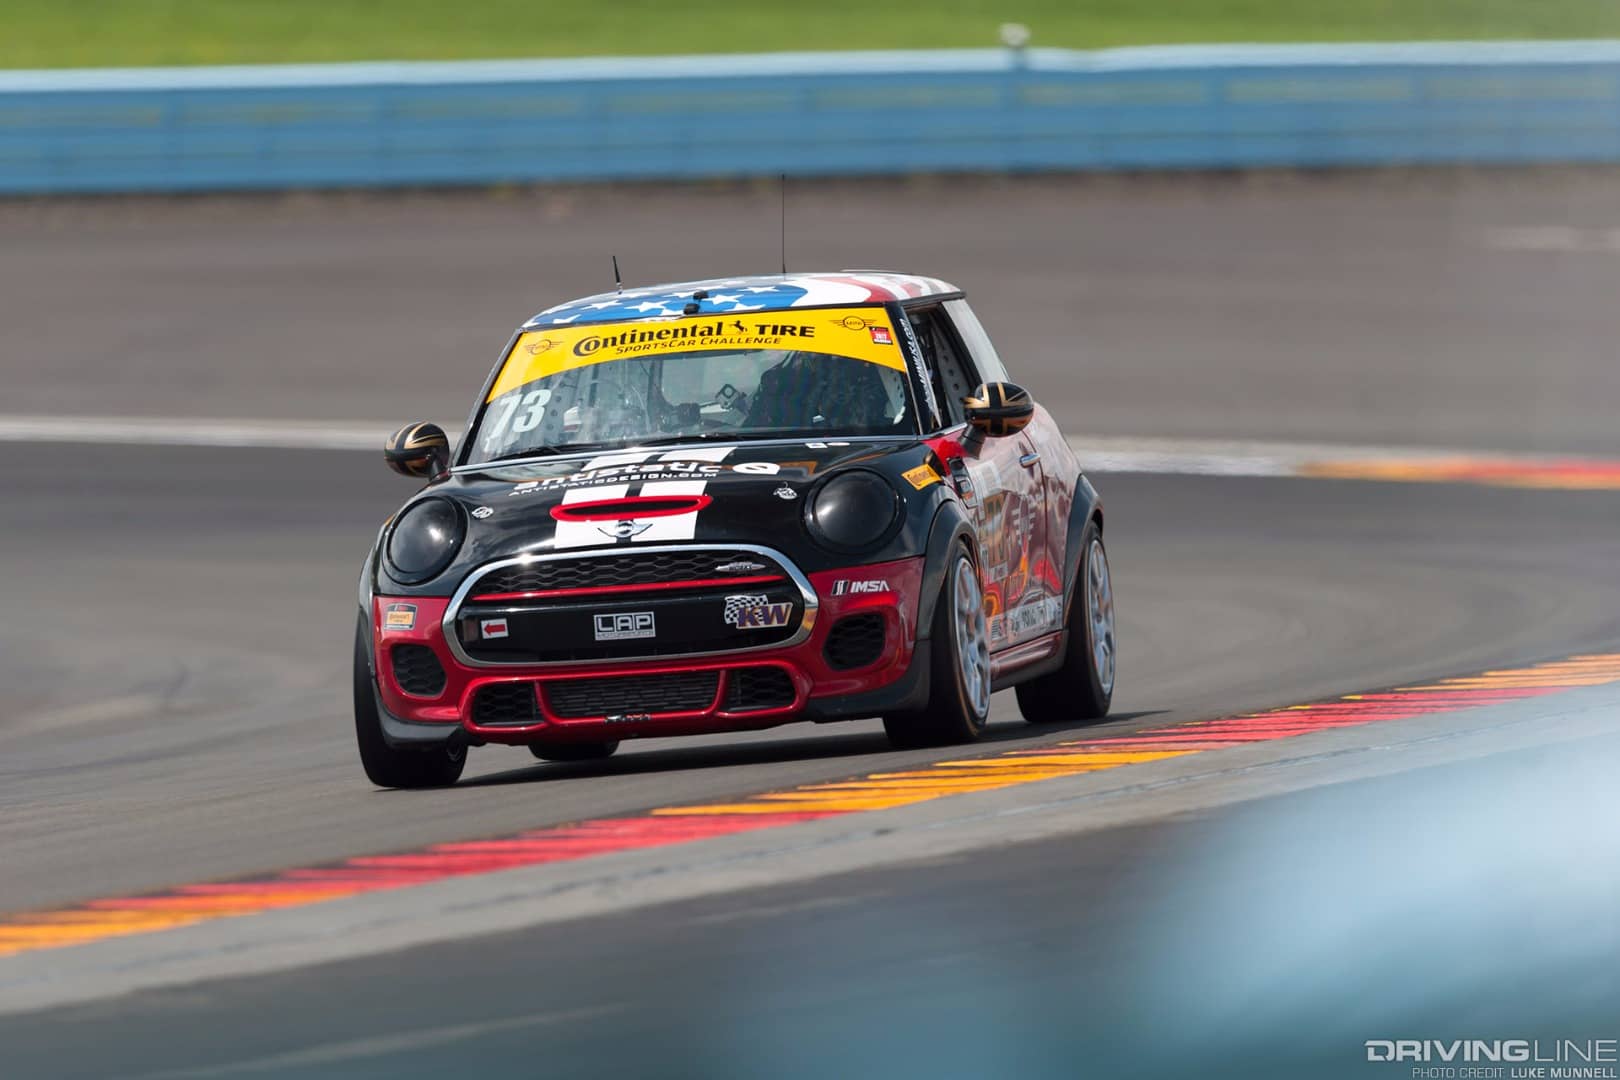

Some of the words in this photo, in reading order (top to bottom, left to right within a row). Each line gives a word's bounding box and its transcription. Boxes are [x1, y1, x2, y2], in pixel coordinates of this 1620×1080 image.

[573, 322, 723, 356] Continental
[755, 324, 816, 338] TIRE
[616, 339, 696, 355] SPORTSCAR
[700, 336, 782, 346] CHALLENGE
[488, 389, 552, 439] 73
[850, 580, 890, 593] IMSA
[597, 614, 652, 631] LAP
[737, 603, 792, 627] KW
